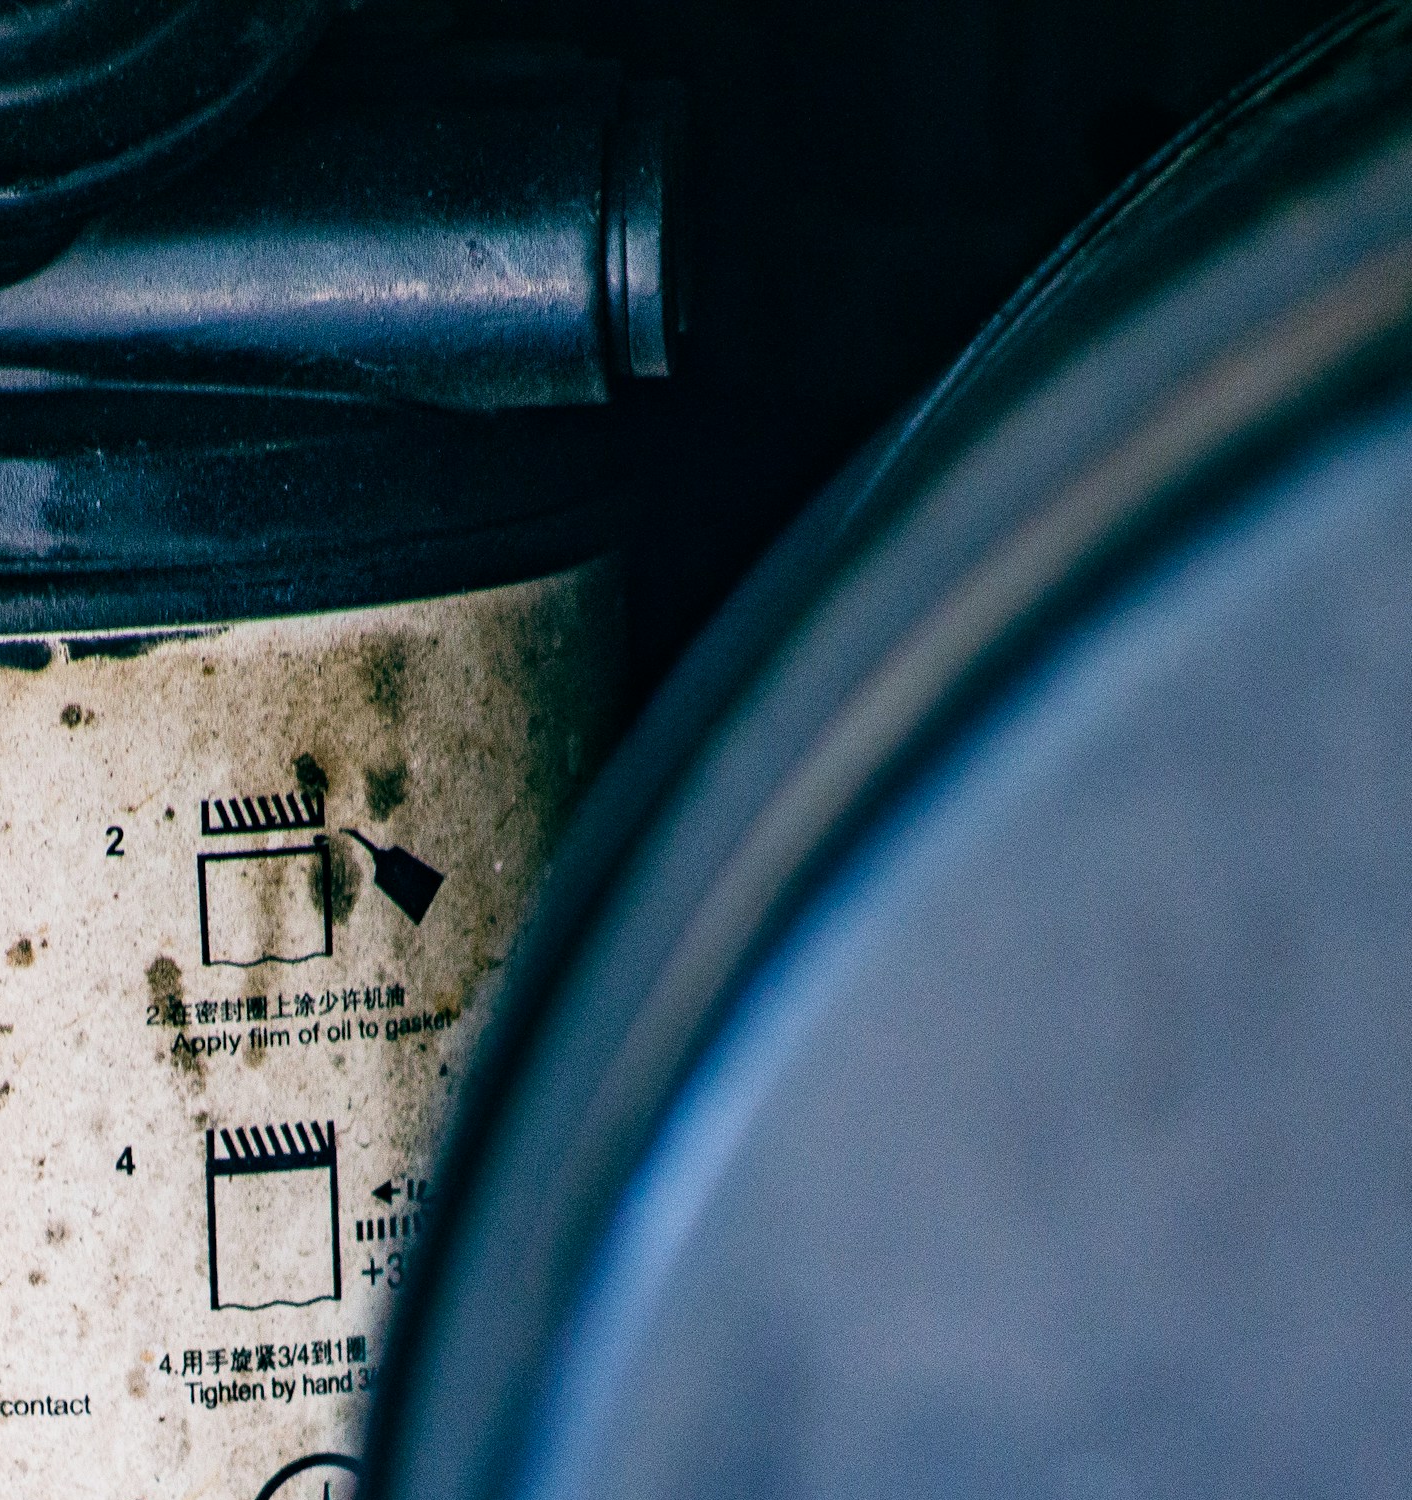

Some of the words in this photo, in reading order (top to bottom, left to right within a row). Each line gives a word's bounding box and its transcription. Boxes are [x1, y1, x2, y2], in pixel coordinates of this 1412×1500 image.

[105, 825, 125, 856] 2
[172, 1031, 241, 1056] Apply
[249, 1025, 290, 1049] film
[299, 1023, 320, 1045] of
[327, 1020, 351, 1042] oil
[359, 1018, 379, 1039] to
[386, 1007, 454, 1042] gasket
[116, 1146, 135, 1175] 4
[185, 1378, 265, 1408] Tighten
[272, 1380, 295, 1403] by
[303, 1370, 353, 1396] hand
[0, 1397, 92, 1417] contact
